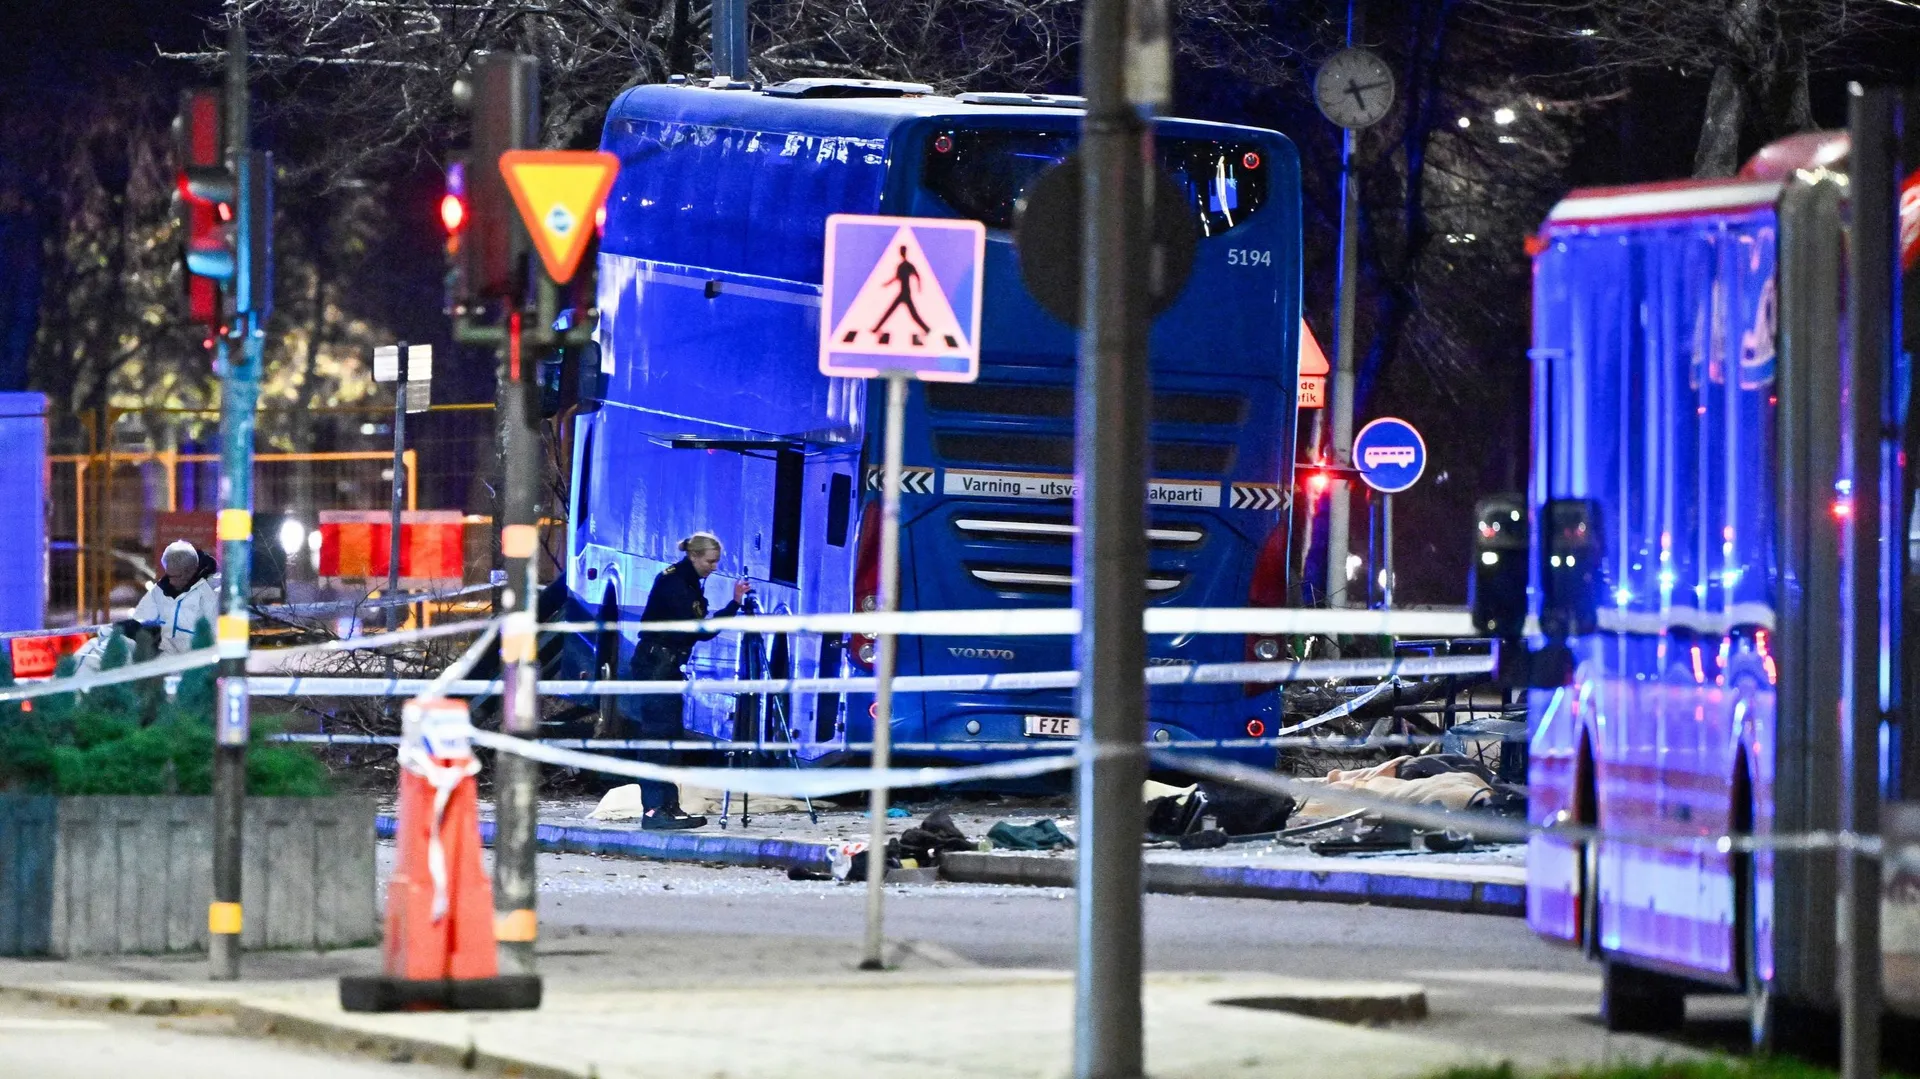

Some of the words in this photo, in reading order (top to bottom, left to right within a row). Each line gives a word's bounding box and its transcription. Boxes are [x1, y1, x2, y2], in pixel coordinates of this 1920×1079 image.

[1227, 248, 1271, 266] 5194
[1300, 382, 1315, 390] de
[1297, 393, 1316, 402] fik
[962, 477, 1021, 496] Varning
[947, 647, 1015, 660] VOLVO
[1039, 718, 1070, 734] FZF
